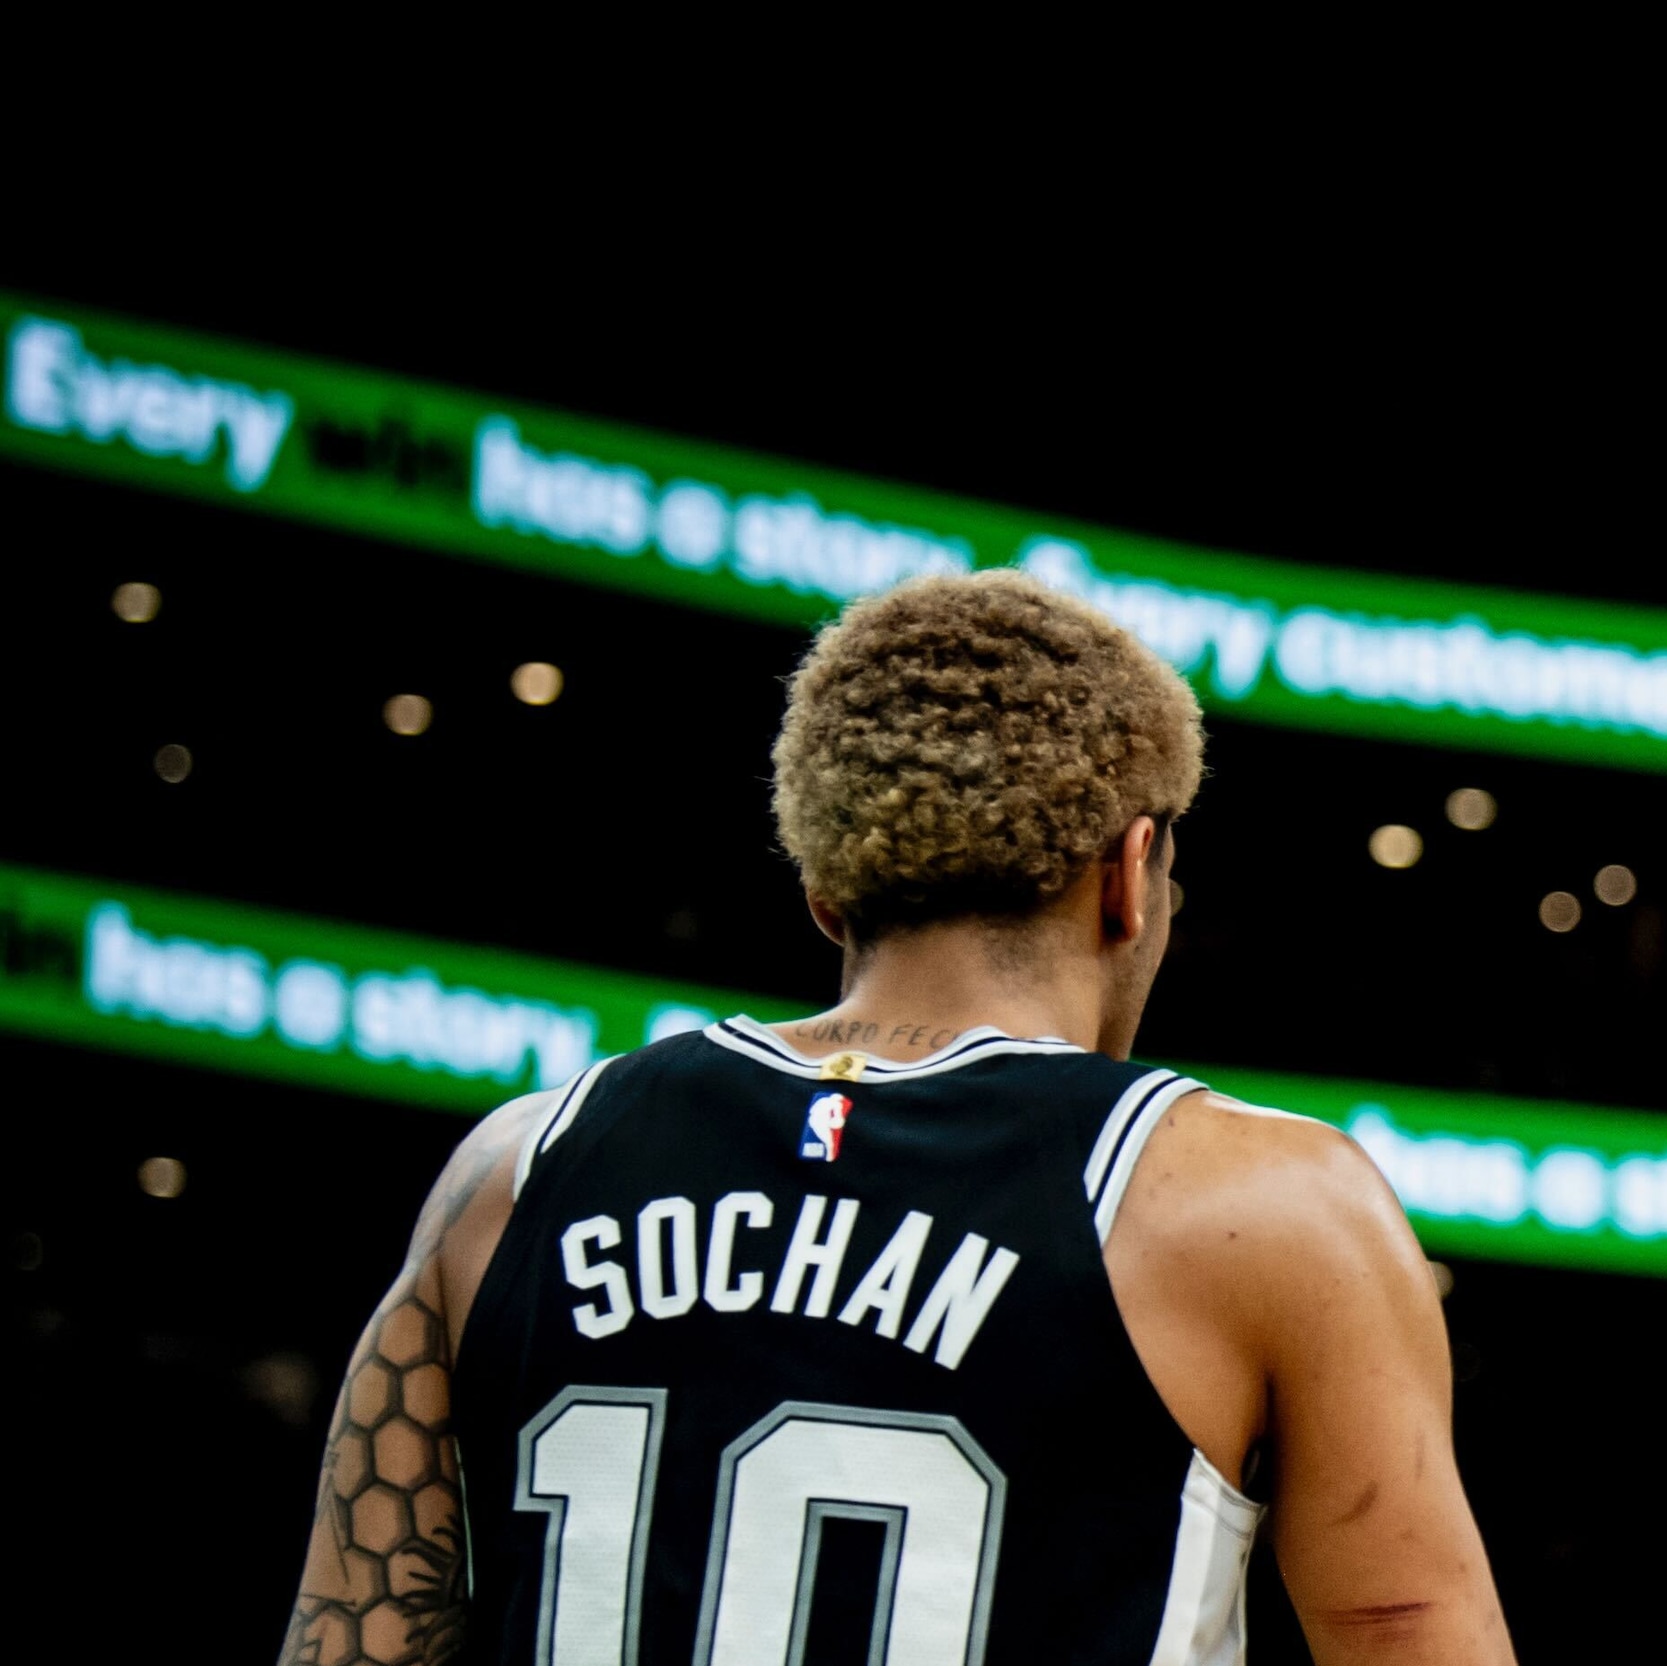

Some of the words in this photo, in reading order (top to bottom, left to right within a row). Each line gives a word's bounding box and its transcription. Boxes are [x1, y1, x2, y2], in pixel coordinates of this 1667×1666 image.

[8, 315, 295, 491] Every
[473, 413, 653, 555] has
[655, 478, 729, 571] a
[84, 901, 268, 1038] has
[271, 956, 350, 1051] a
[1532, 1144, 1607, 1235] a
[561, 1191, 1019, 1370] SOCHAN
